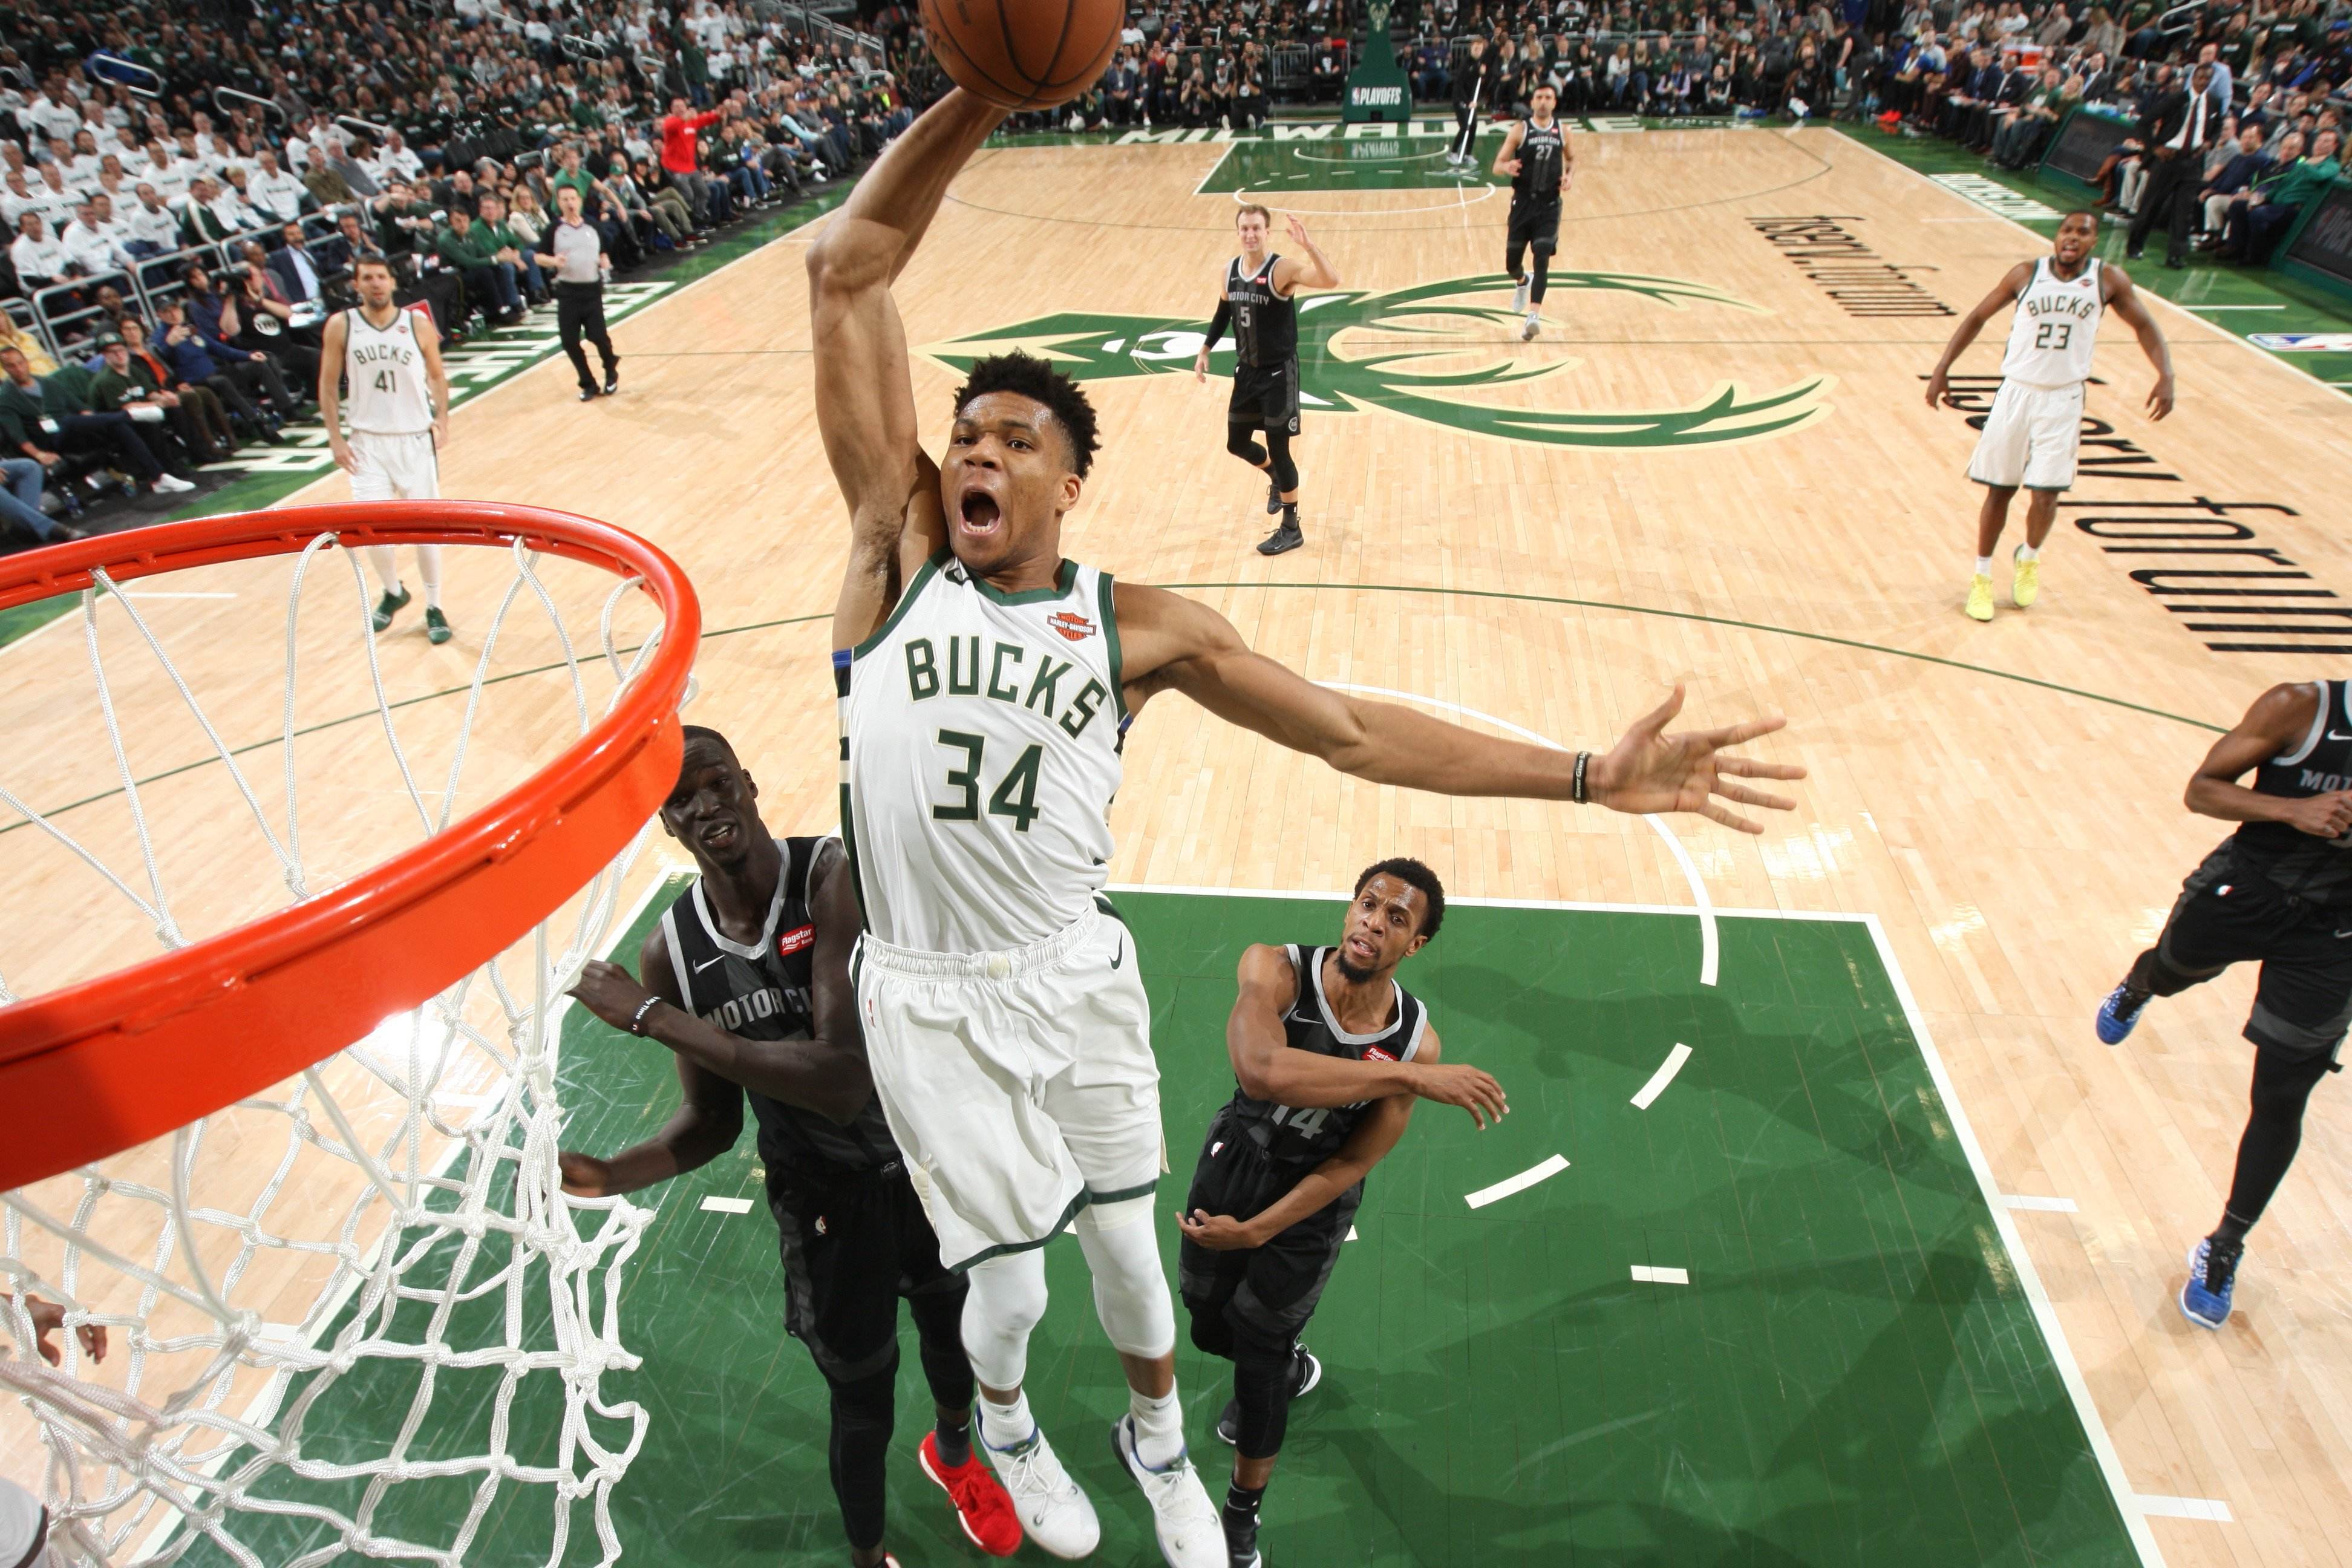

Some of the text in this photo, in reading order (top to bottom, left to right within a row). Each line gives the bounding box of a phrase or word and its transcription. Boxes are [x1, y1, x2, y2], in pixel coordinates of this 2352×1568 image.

[1359, 87, 1402, 106] PLAYOFFS
[1535, 145, 1553, 161] 27
[1228, 291, 1269, 305] MOTOR CITY
[2027, 295, 2096, 319] BUCKS
[1240, 306, 1251, 328] 5
[2036, 323, 2073, 349] 23
[353, 344, 413, 366] BUCKS
[374, 369, 396, 393] 41
[1049, 617, 1094, 633] HARLEY-DAVIDSON
[904, 635, 1108, 741] BUCKS
[930, 728, 1045, 833] 34
[782, 929, 812, 946] Flagstar
[702, 987, 786, 1030] MOTOR
